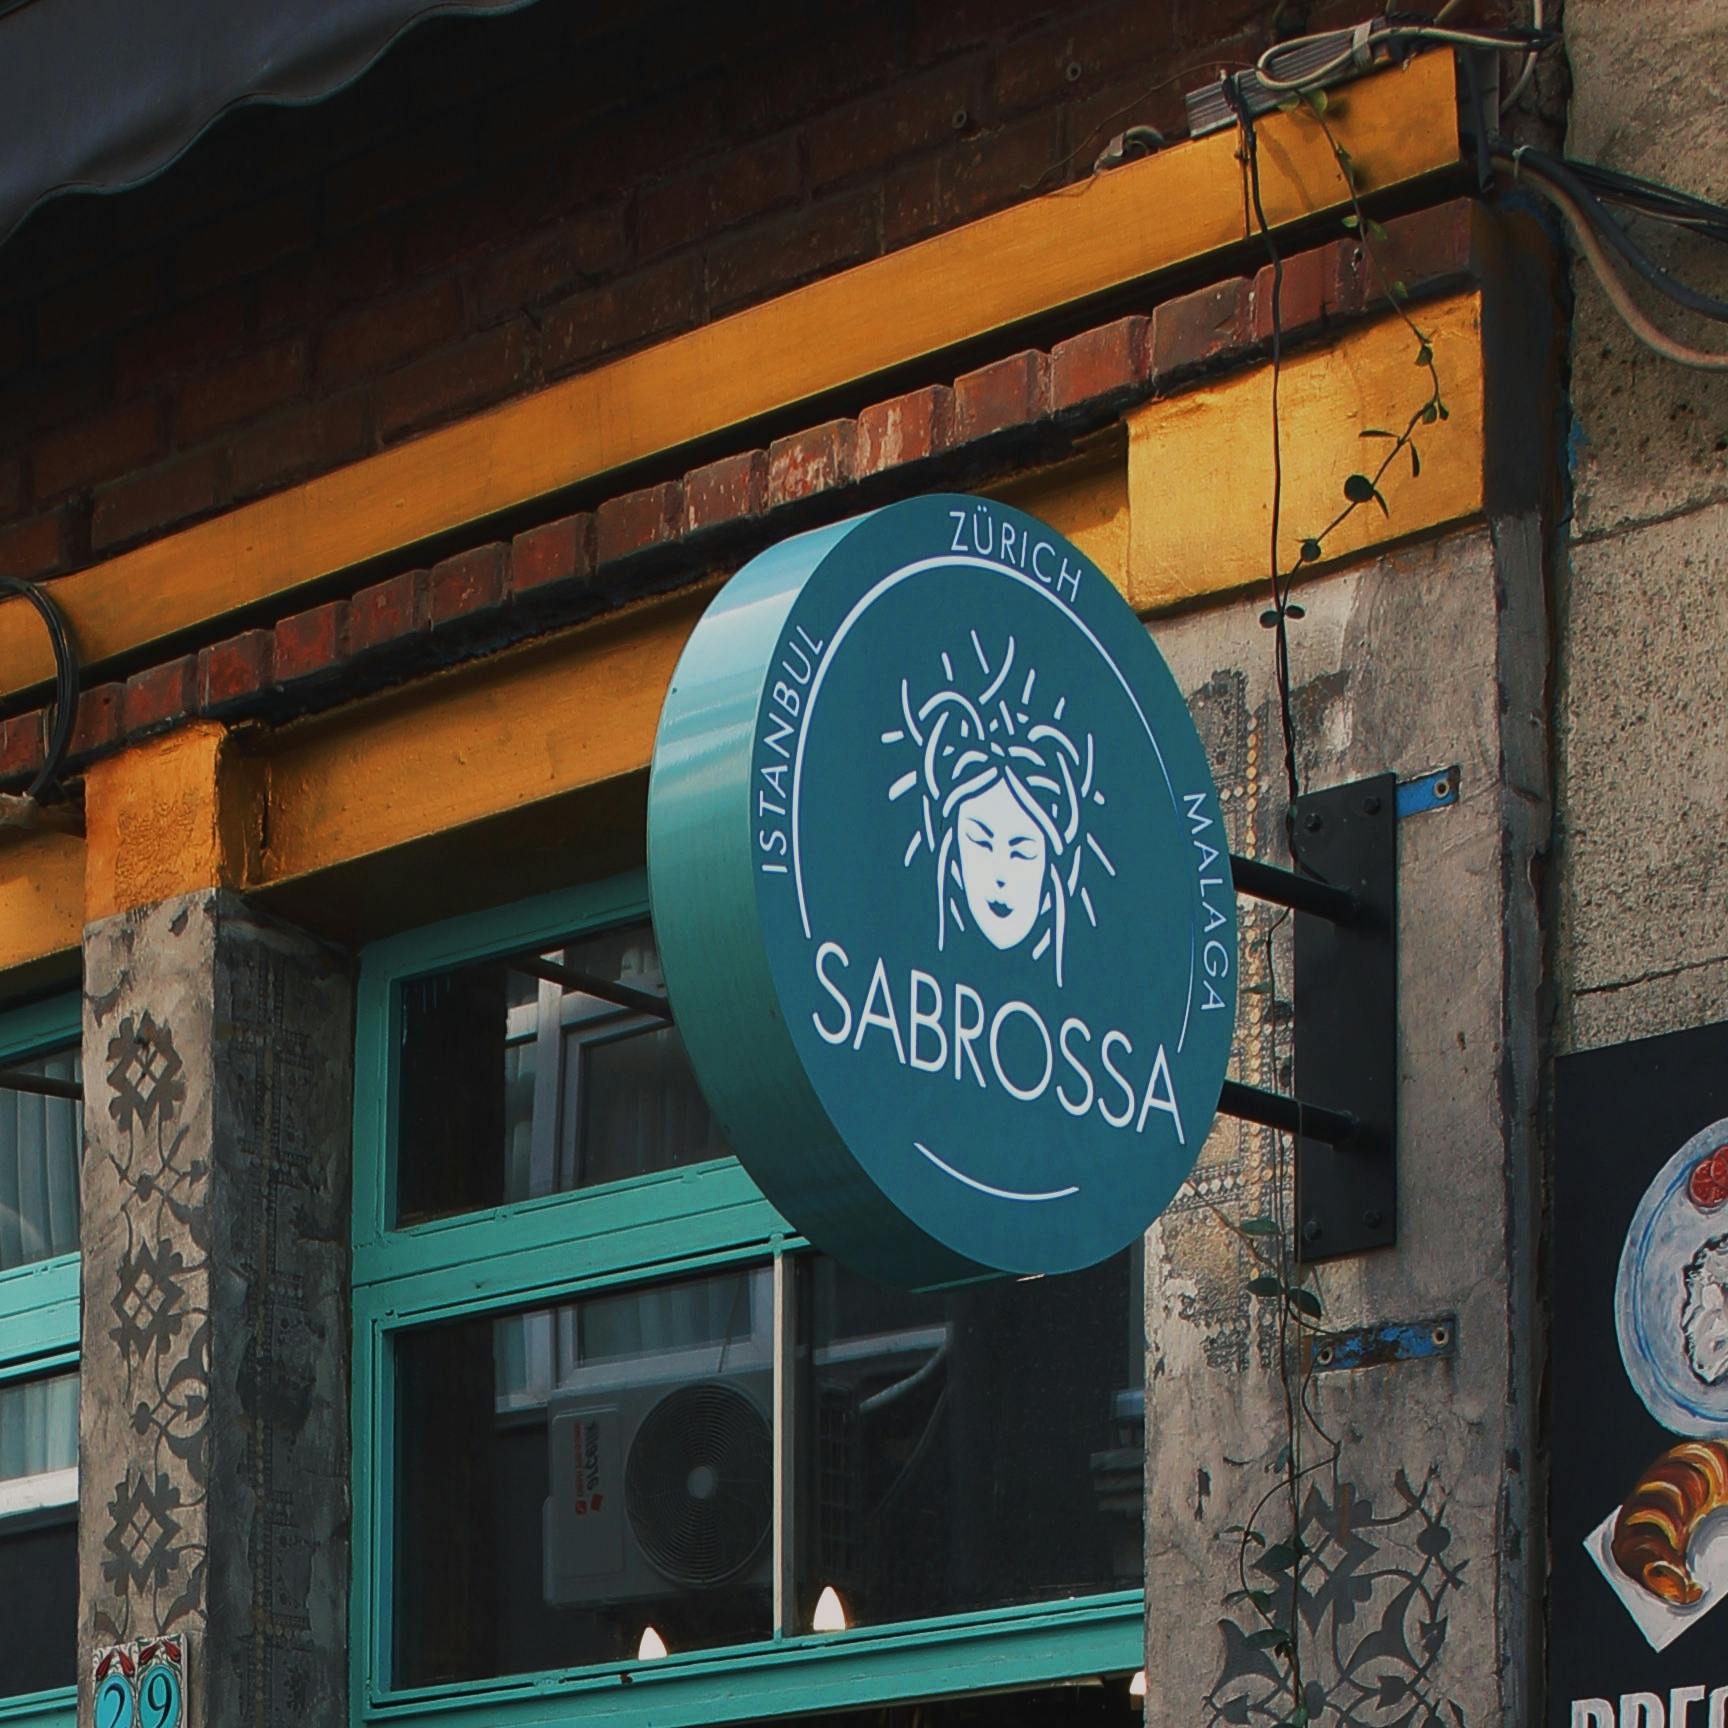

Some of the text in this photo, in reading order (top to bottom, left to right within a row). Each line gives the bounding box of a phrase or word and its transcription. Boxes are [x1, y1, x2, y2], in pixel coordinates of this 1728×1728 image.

[948, 506, 1083, 603] ZÜRICH
[760, 625, 824, 873] ISTANBUL
[1182, 792, 1228, 1010] MALAGA
[812, 942, 1186, 1144] SABROSSA
